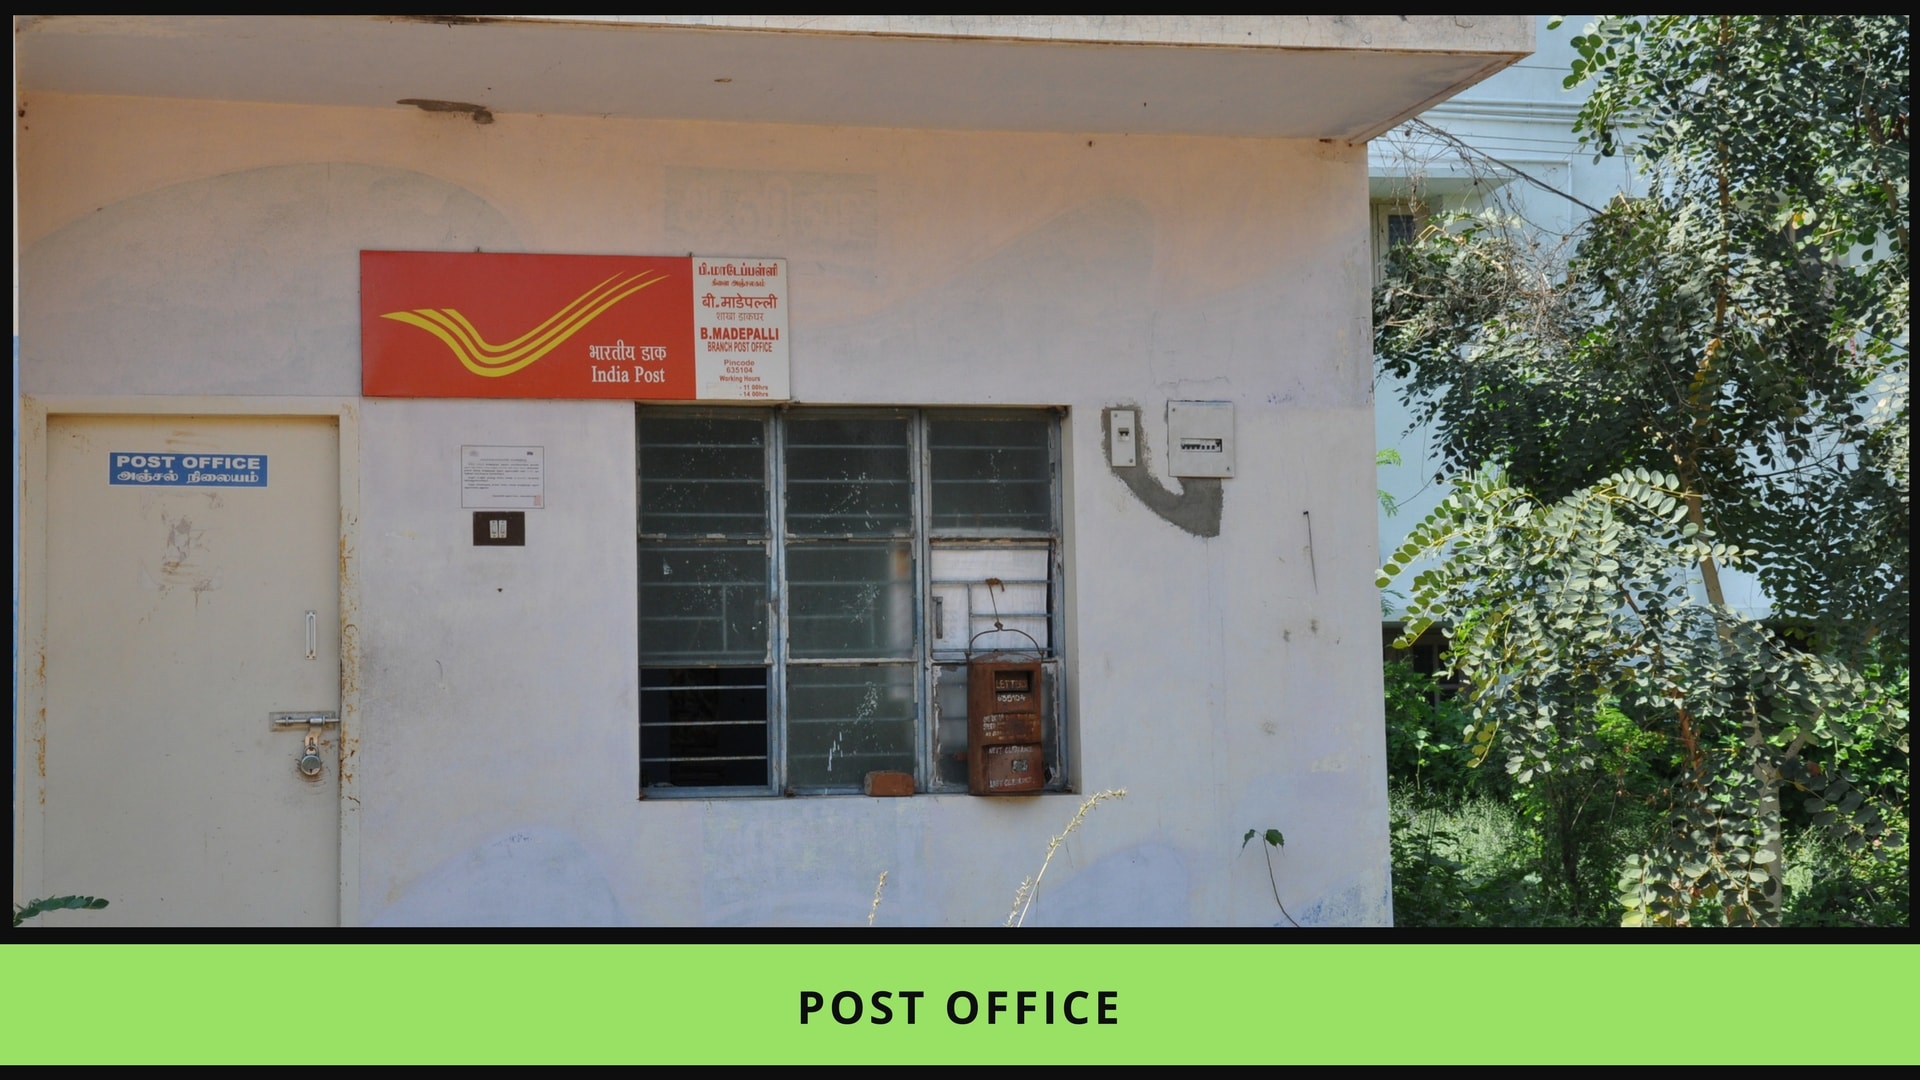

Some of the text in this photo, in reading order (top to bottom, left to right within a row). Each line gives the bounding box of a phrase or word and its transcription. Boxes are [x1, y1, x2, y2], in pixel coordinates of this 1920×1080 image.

[702, 292, 778, 309] बी.माडेपल्ली
[716, 311, 764, 322] शाखा डाकघर
[700, 327, 779, 340] B.MADEPALLI
[589, 339, 667, 361] भारतीय डाक
[707, 341, 773, 353] BRANCH POST OFFICE
[723, 359, 755, 367] Pincode
[591, 365, 666, 383] India Post
[719, 375, 743, 383] Working
[116, 455, 261, 469] POST OFFICE
[117, 469, 259, 484] அஞ்சல் நிலையம்
